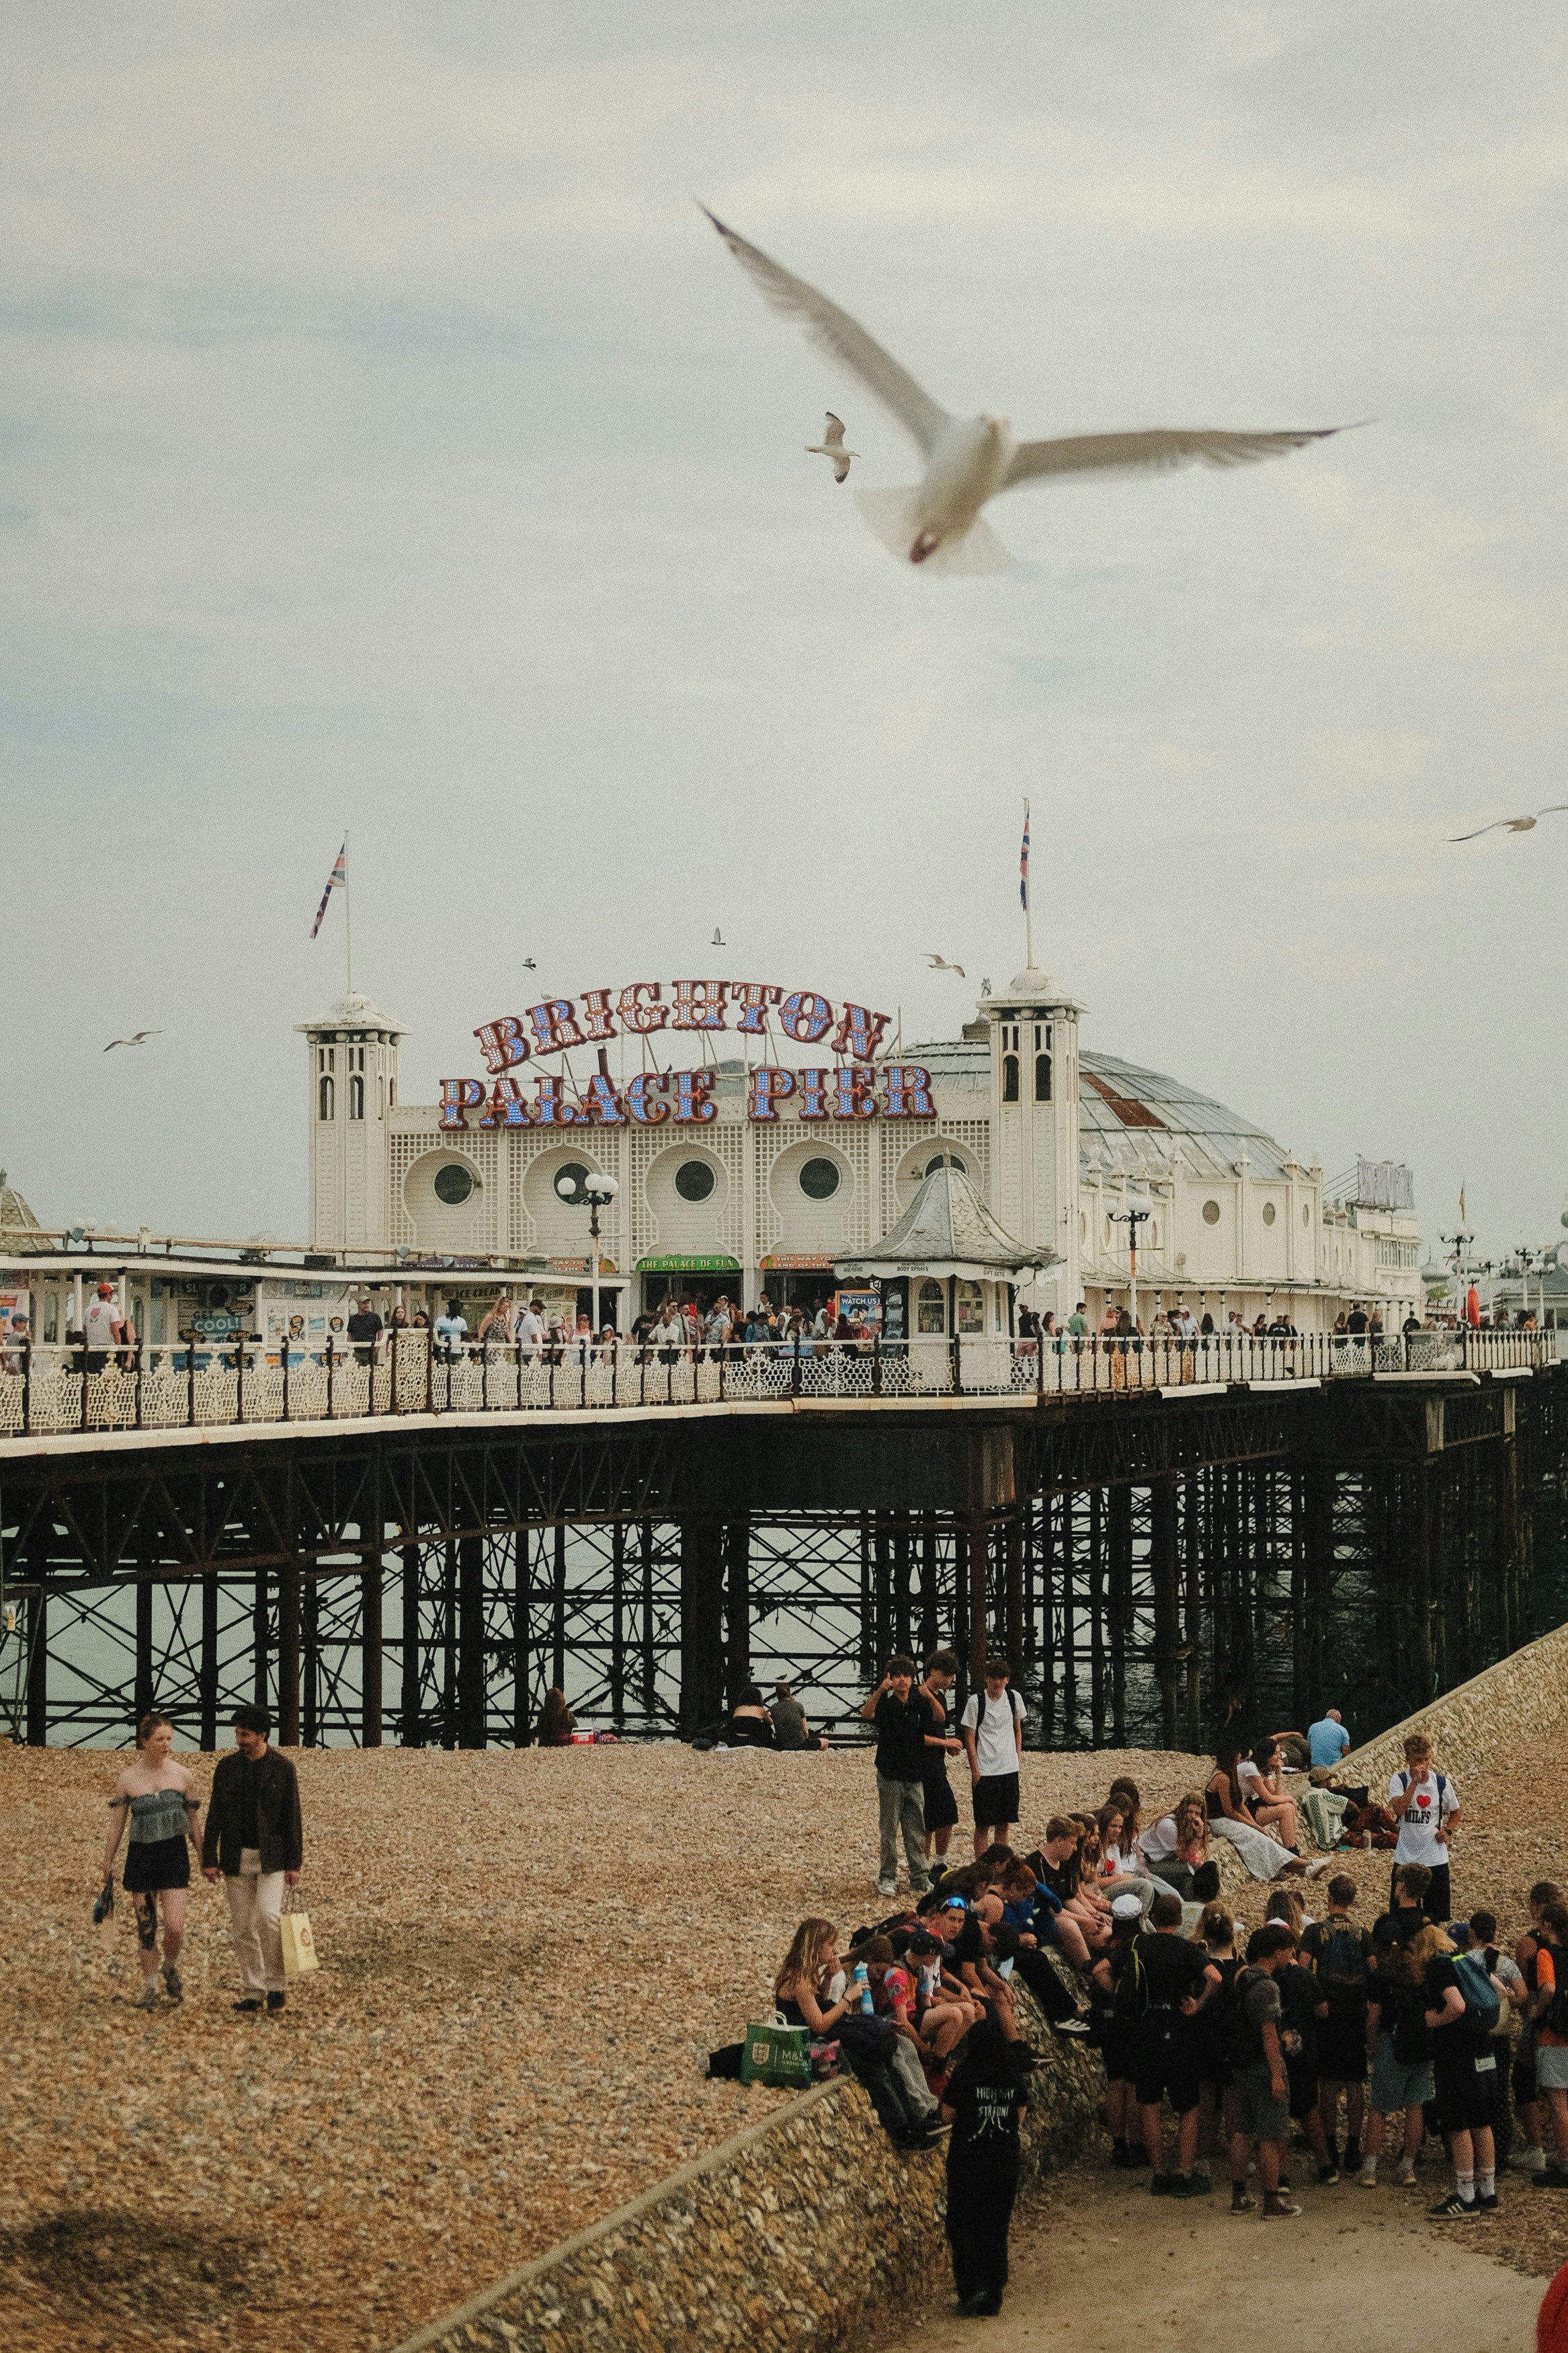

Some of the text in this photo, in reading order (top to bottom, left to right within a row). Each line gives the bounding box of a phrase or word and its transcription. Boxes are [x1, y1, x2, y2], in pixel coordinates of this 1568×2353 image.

[473, 980, 893, 1075] BRIGHTON
[438, 1066, 938, 1131] PALACE PIER
[642, 1261, 658, 1269] THE
[663, 1260, 696, 1268] PALACE
[716, 1259, 734, 1267] FUN
[194, 1310, 214, 1319] GET
[195, 1316, 240, 1331] COOL!
[1405, 1809, 1431, 1824] MILFS
